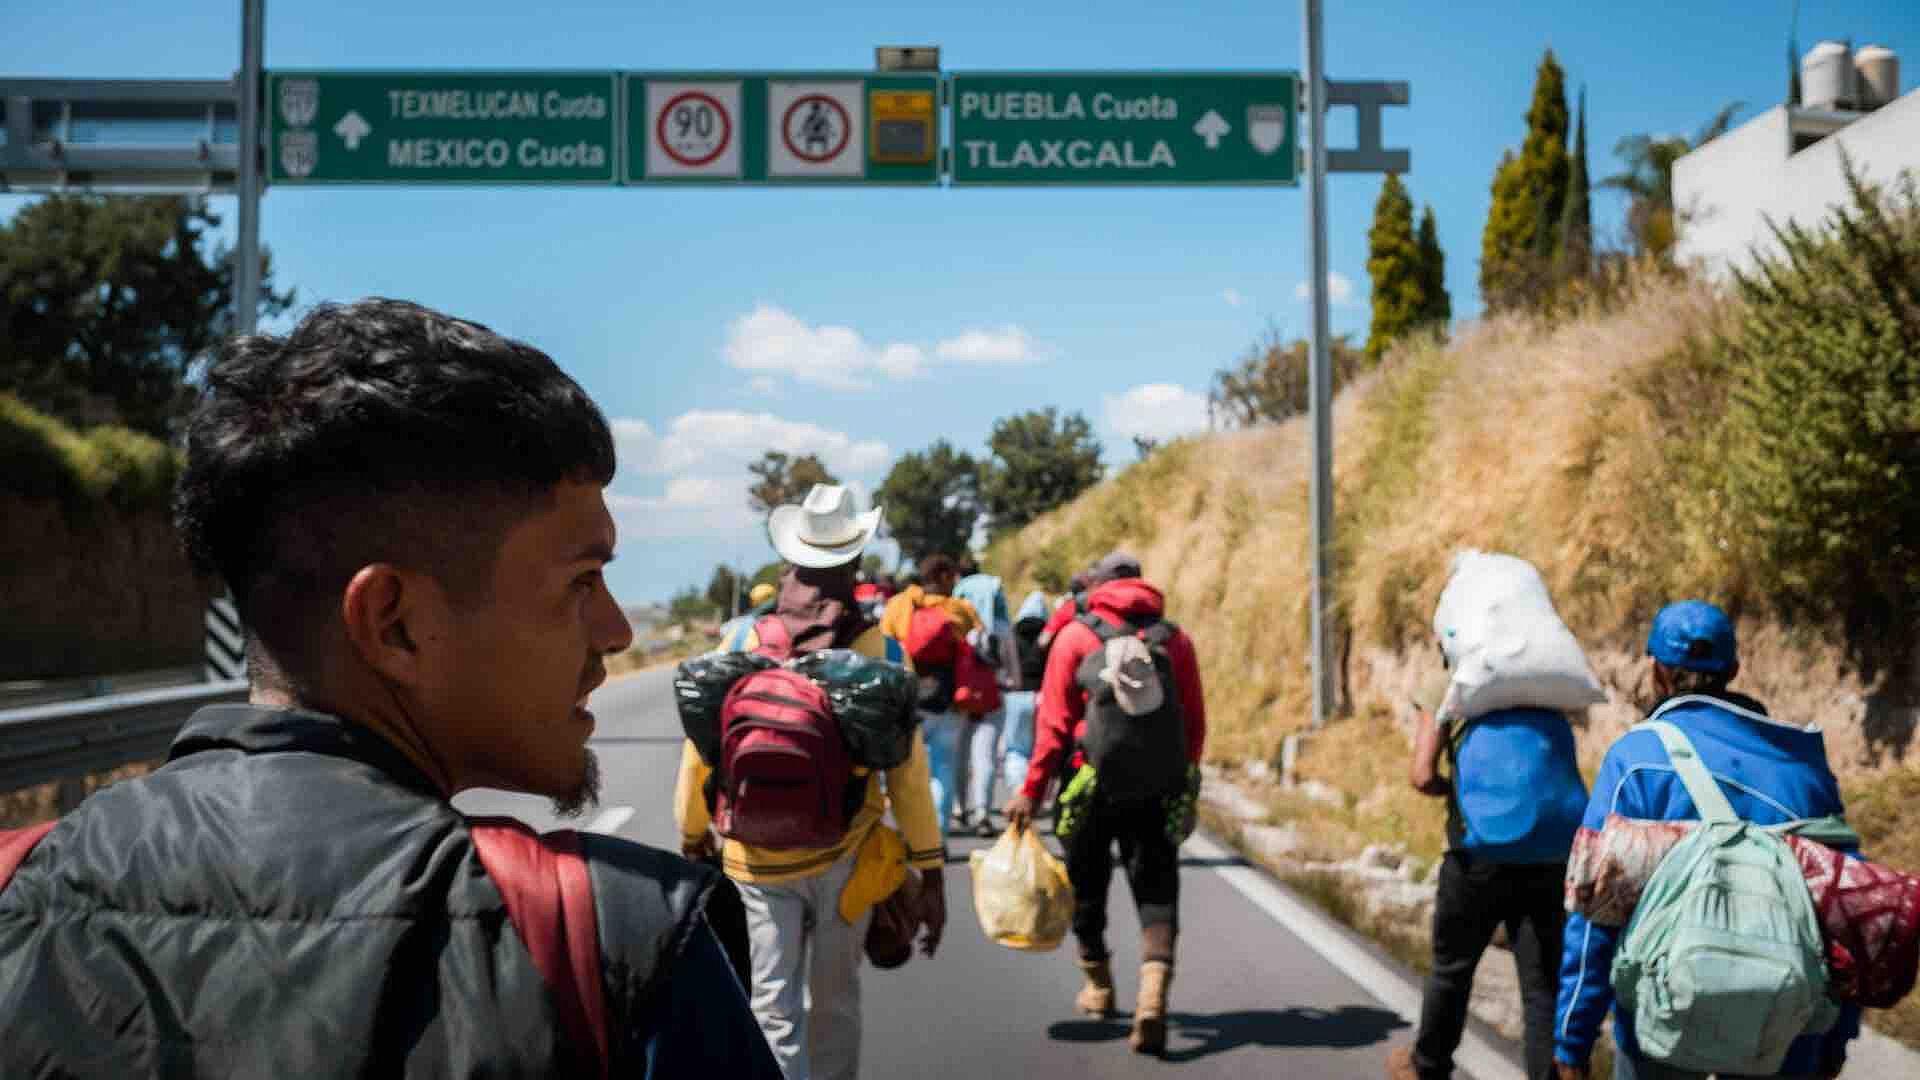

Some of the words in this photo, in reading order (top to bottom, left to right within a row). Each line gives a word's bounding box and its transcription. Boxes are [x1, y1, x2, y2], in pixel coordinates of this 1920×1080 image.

[388, 90, 539, 119] TEXMELUCAN
[543, 90, 607, 119] Cuota
[960, 91, 1086, 120] PUEBLA
[1091, 92, 1178, 121] Cuota
[674, 105, 713, 139] 90
[387, 139, 509, 168] MEXICO
[517, 138, 606, 168] Cuota
[963, 140, 1177, 169] TLAXCALA
